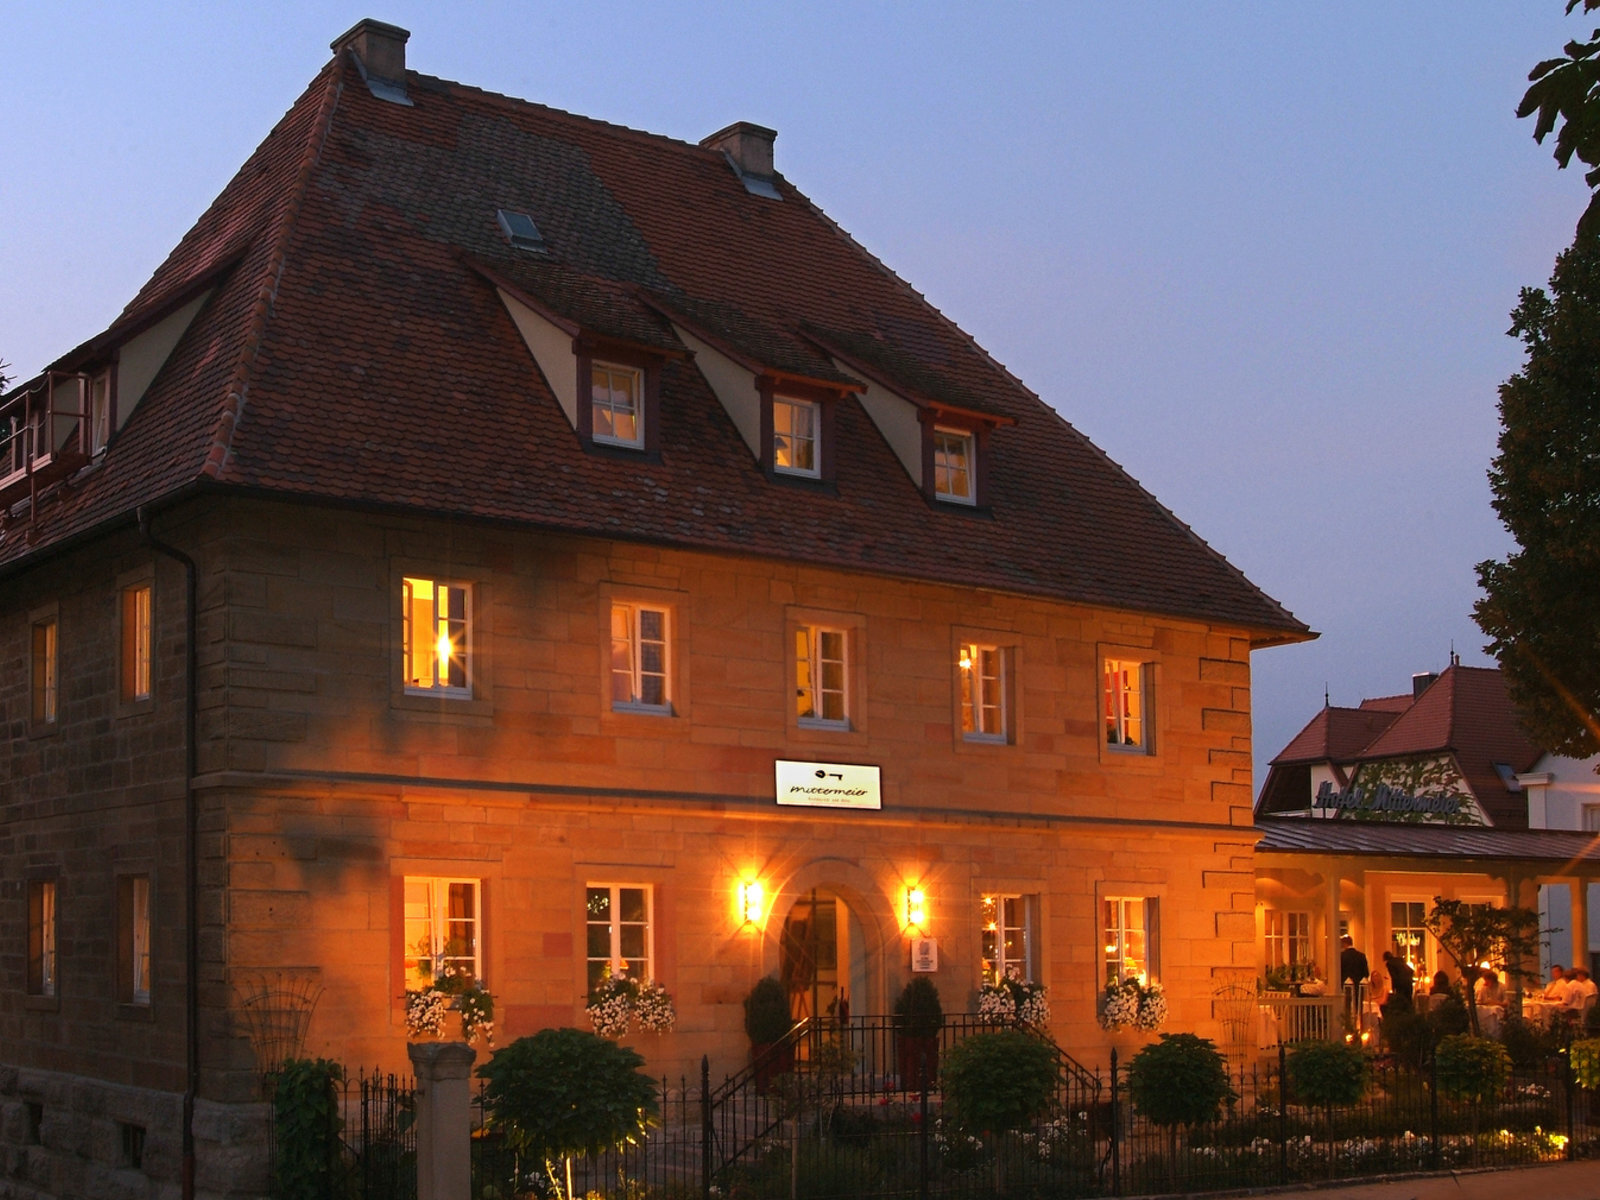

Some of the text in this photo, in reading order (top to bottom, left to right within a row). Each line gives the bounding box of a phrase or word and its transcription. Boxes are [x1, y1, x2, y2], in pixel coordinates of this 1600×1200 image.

[790, 785, 868, 797] mittermeier
[1314, 781, 1461, 814] Hotel Mittermeier
